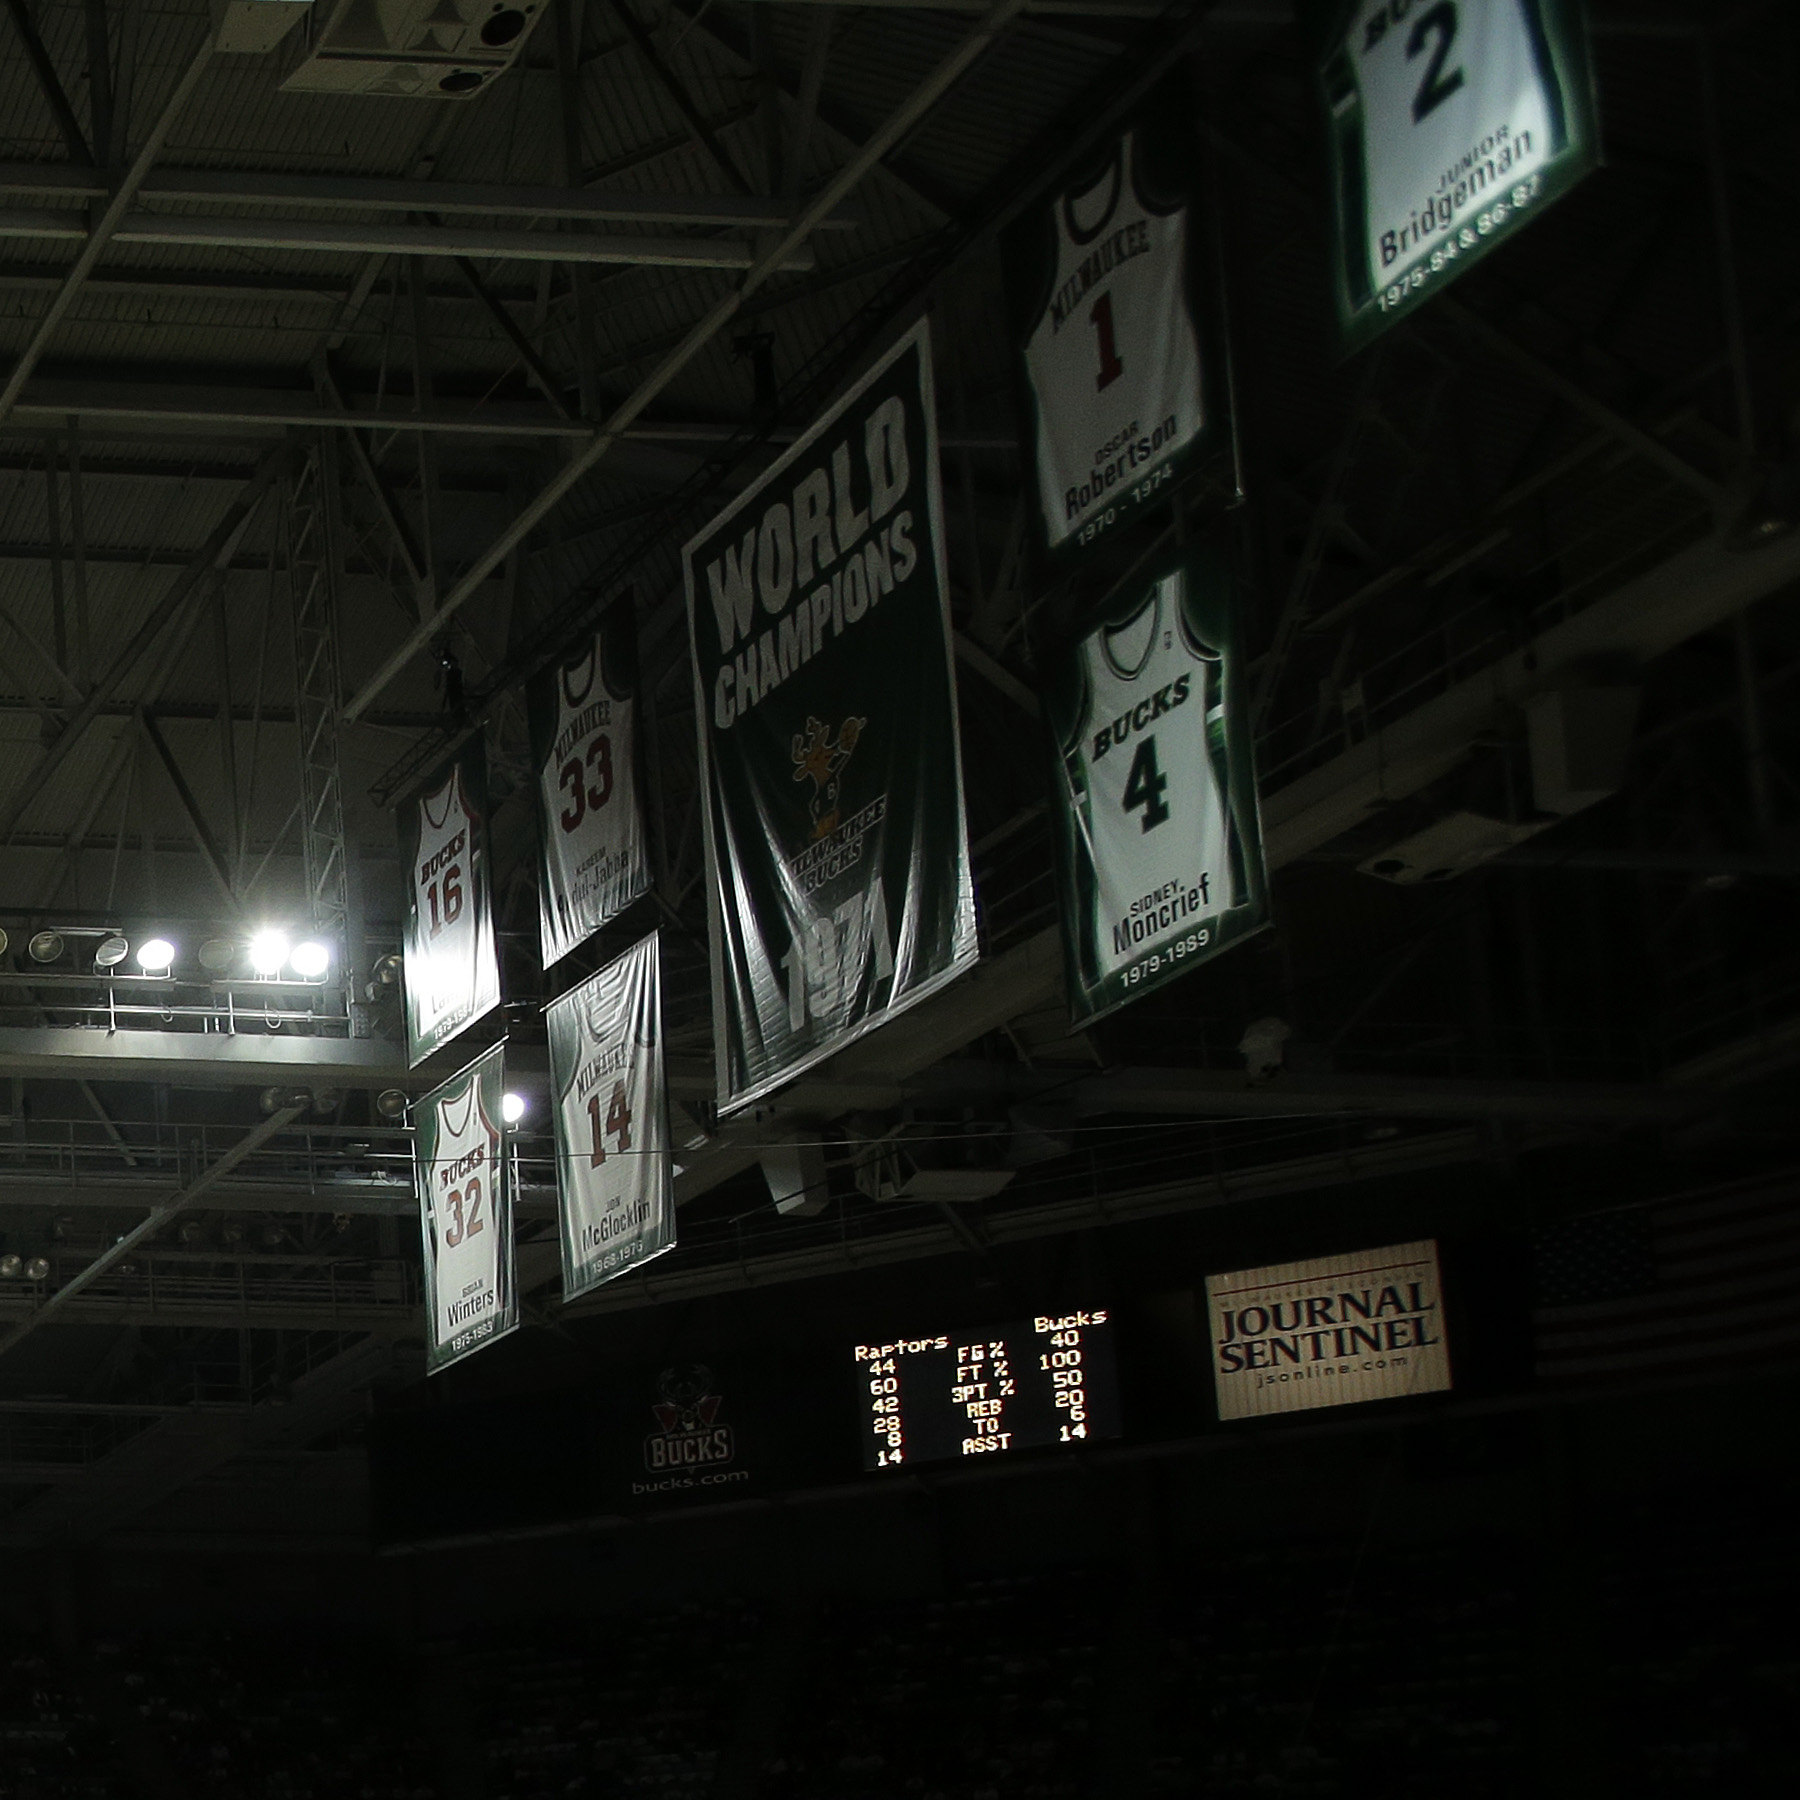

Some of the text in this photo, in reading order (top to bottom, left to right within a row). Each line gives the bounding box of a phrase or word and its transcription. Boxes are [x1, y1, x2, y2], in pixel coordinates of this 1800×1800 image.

[1378, 129, 1533, 269] Bridgeman
[1051, 219, 1151, 334] MILWAUKEE
[1089, 291, 1123, 394] 1
[1064, 414, 1177, 520] Robertson
[706, 396, 910, 654] WORLD
[714, 511, 917, 731] CHAMPIONS
[554, 701, 611, 769] MILWAUKEE
[1091, 672, 1192, 763] BUCKS
[559, 734, 613, 833] 33
[1121, 734, 1171, 836] 4
[421, 828, 466, 885] BUCKS
[802, 838, 862, 896] BUCKS
[427, 863, 462, 940] 16
[1112, 872, 1211, 956] Moncrief
[1129, 878, 1180, 919] SIDNEY
[781, 873, 894, 1034] 1971
[1120, 927, 1210, 988] 1979-1989
[587, 1079, 632, 1169] 14
[439, 1142, 486, 1193] BUCKS
[445, 1173, 485, 1248] 32
[582, 1199, 650, 1251] McGlocklin
[447, 1286, 495, 1327] Winters
[855, 1311, 1107, 1361] Raptors Bucks
[1219, 1282, 1435, 1344] JOURNAL
[957, 1365, 982, 1382] FT
[958, 1345, 984, 1363] FG
[1220, 1316, 1439, 1374] SENTINEL
[1257, 1357, 1407, 1388] jsonline.com
[650, 1428, 730, 1468] BUCKS
[632, 1470, 750, 1495] bucks.com
